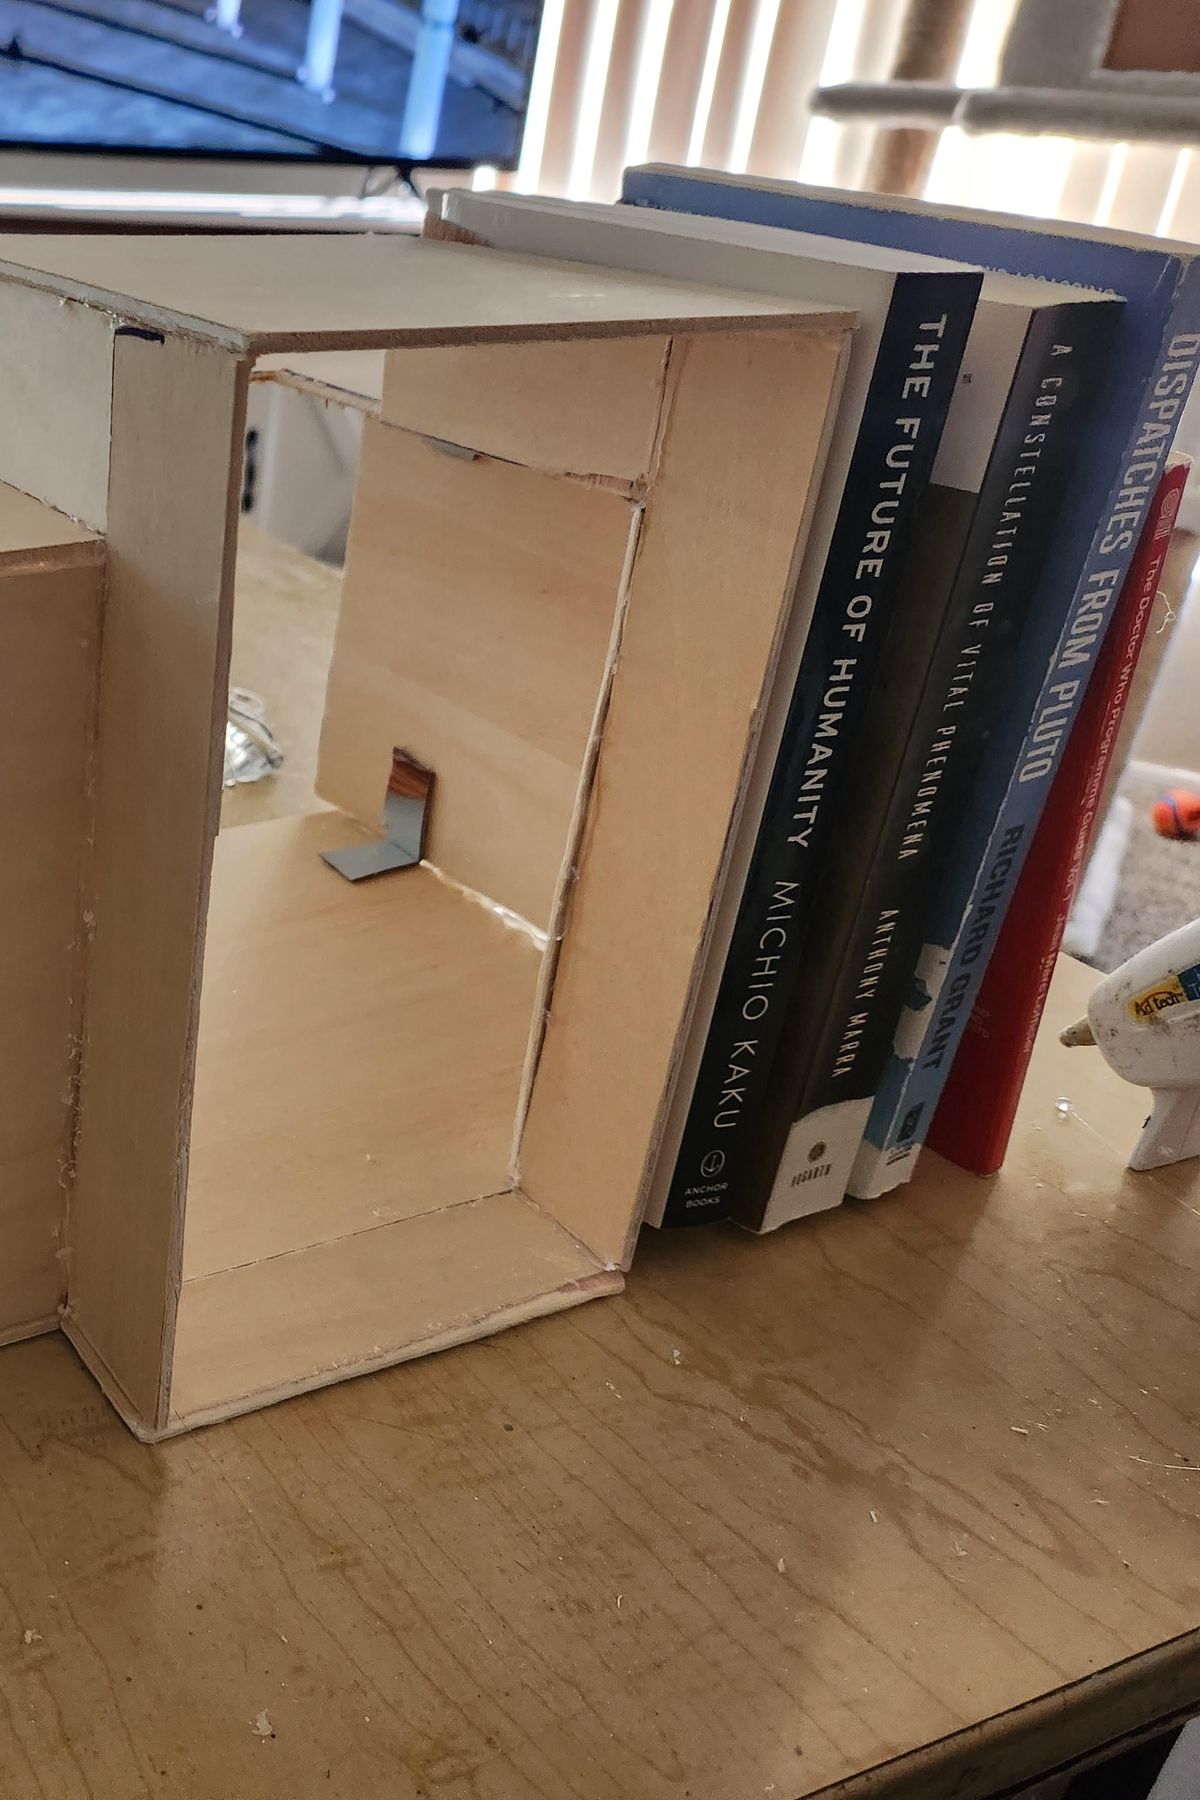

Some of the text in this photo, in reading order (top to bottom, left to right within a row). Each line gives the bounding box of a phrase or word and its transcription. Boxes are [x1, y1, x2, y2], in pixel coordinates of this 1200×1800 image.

[1144, 554, 1161, 593] The
[1125, 596, 1151, 660] Doctor
[832, 343, 1072, 1079] A CONSTELLATION OF VITAL PHENOMENA ANTHONY MARRA
[921, 333, 1200, 1071] DISPATCHES FROM PLUTO RICHARD GRANT
[1114, 662, 1134, 704] Who
[713, 313, 948, 1130] THE FUTURE OF HUMANITY MICHIO KAKU
[1086, 708, 1120, 807] Programme
[684, 1182, 728, 1196] ANCHOR
[685, 1196, 720, 1208] BOOKS
